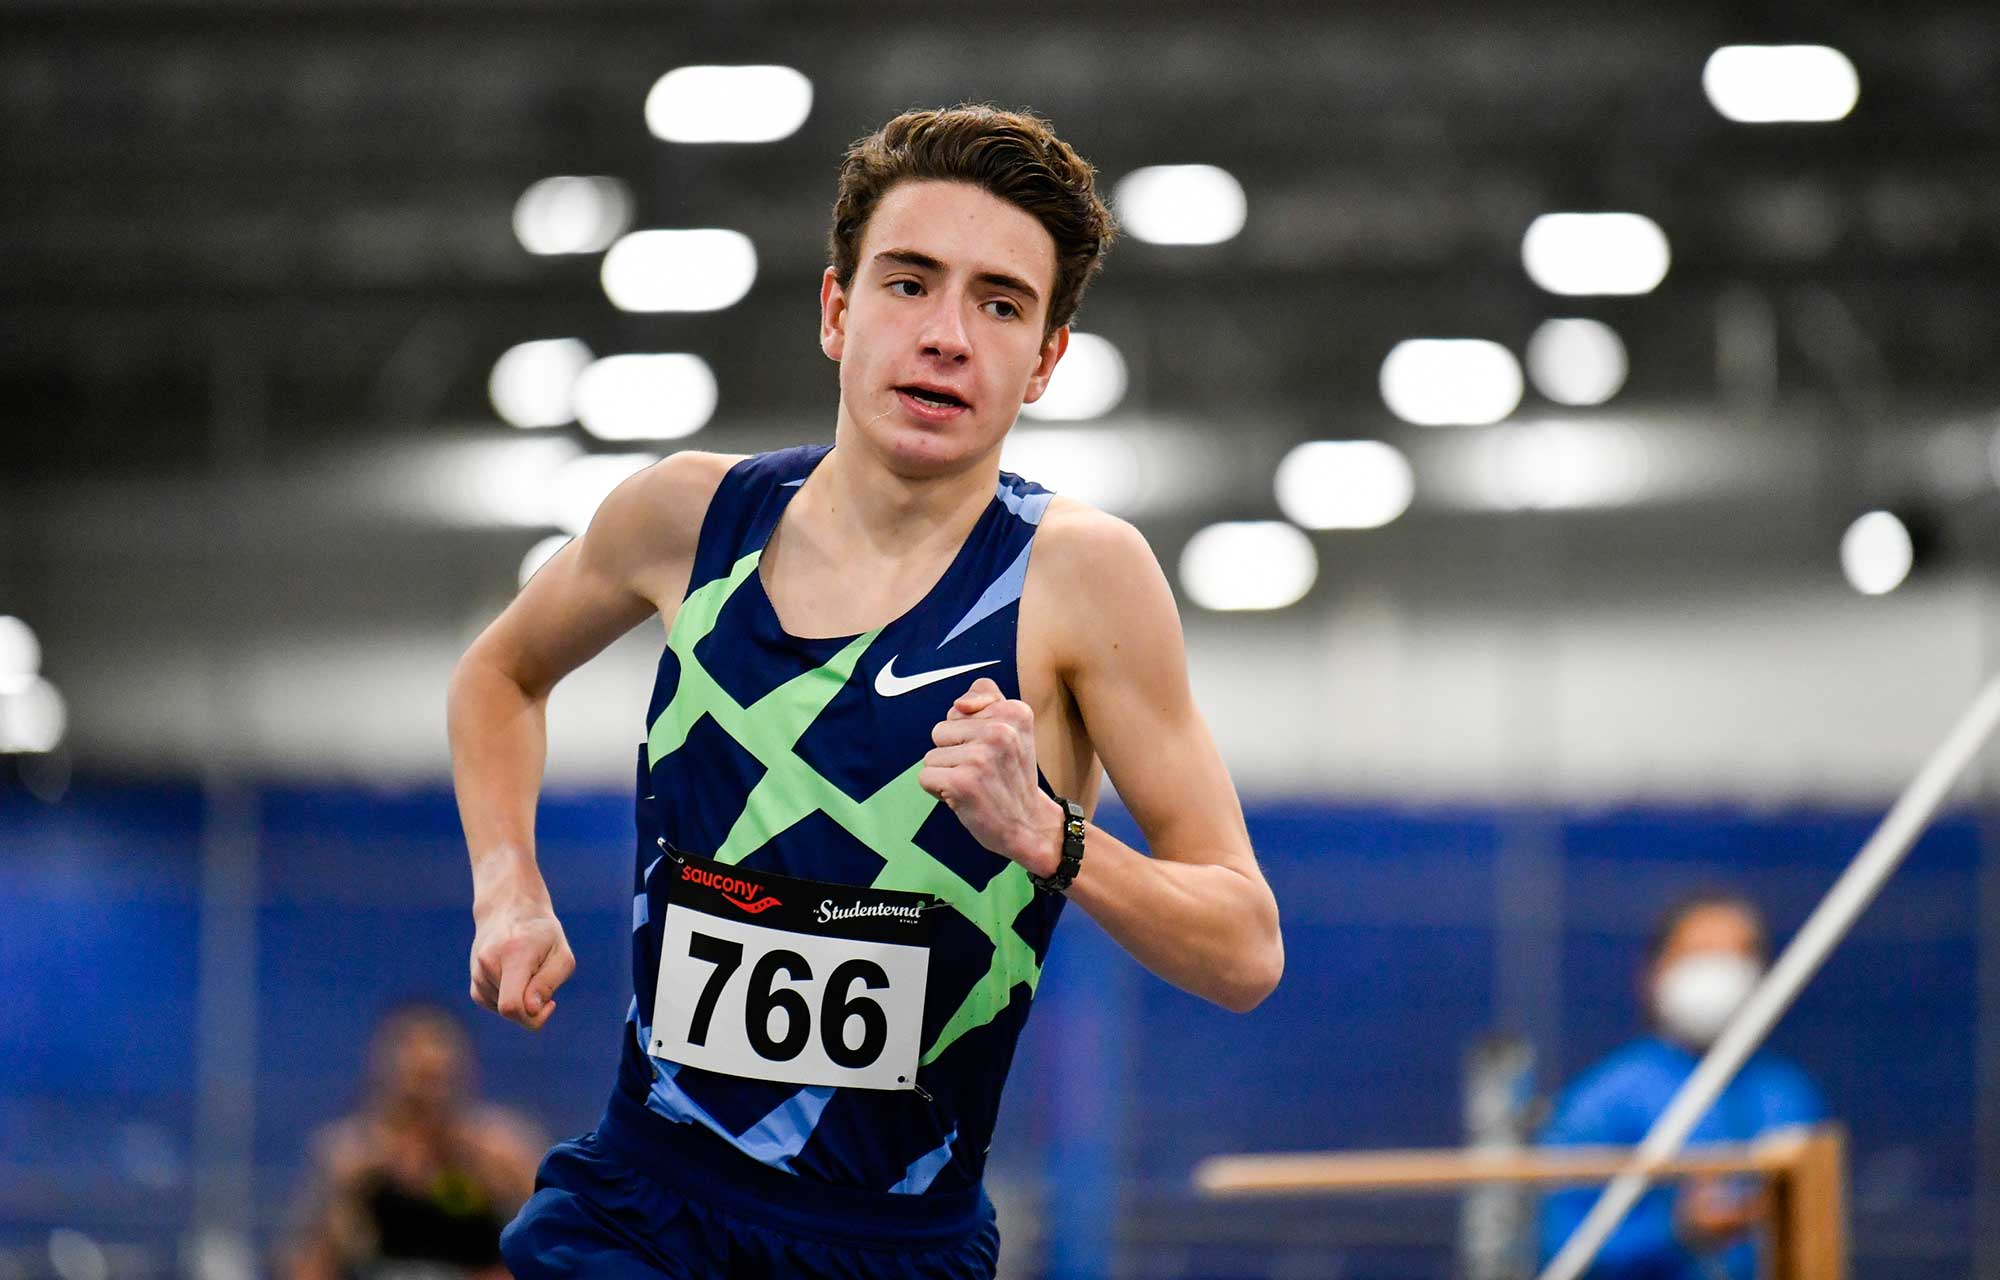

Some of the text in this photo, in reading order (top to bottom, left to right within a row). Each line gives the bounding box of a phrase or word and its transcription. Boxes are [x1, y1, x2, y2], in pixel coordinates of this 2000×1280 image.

[682, 865, 759, 900] saucony
[817, 900, 921, 923] Studenterna
[687, 931, 890, 1069] 766
